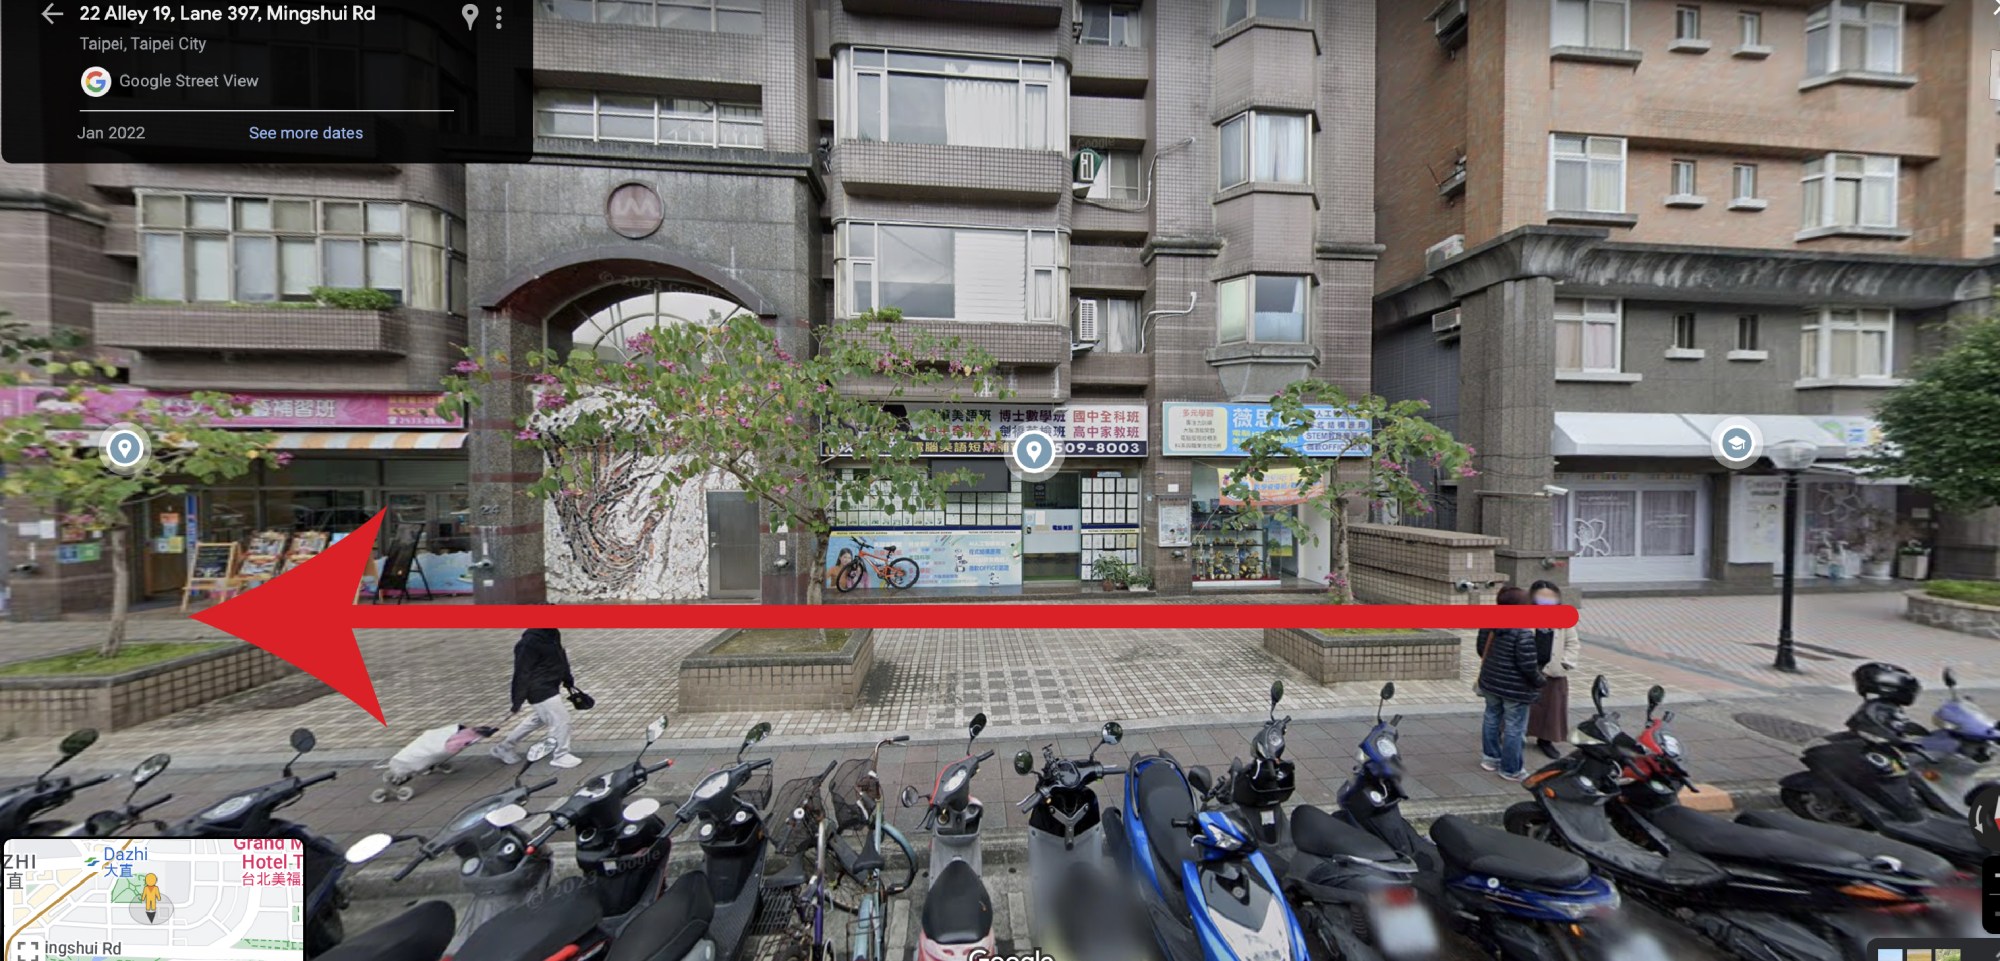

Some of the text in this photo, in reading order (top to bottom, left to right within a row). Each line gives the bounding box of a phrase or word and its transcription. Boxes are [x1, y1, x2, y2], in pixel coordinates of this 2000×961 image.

[999, 408, 1067, 424] 博士數學班
[1073, 409, 1140, 424] 國中全科班
[1073, 425, 1140, 439] 高中家教班
